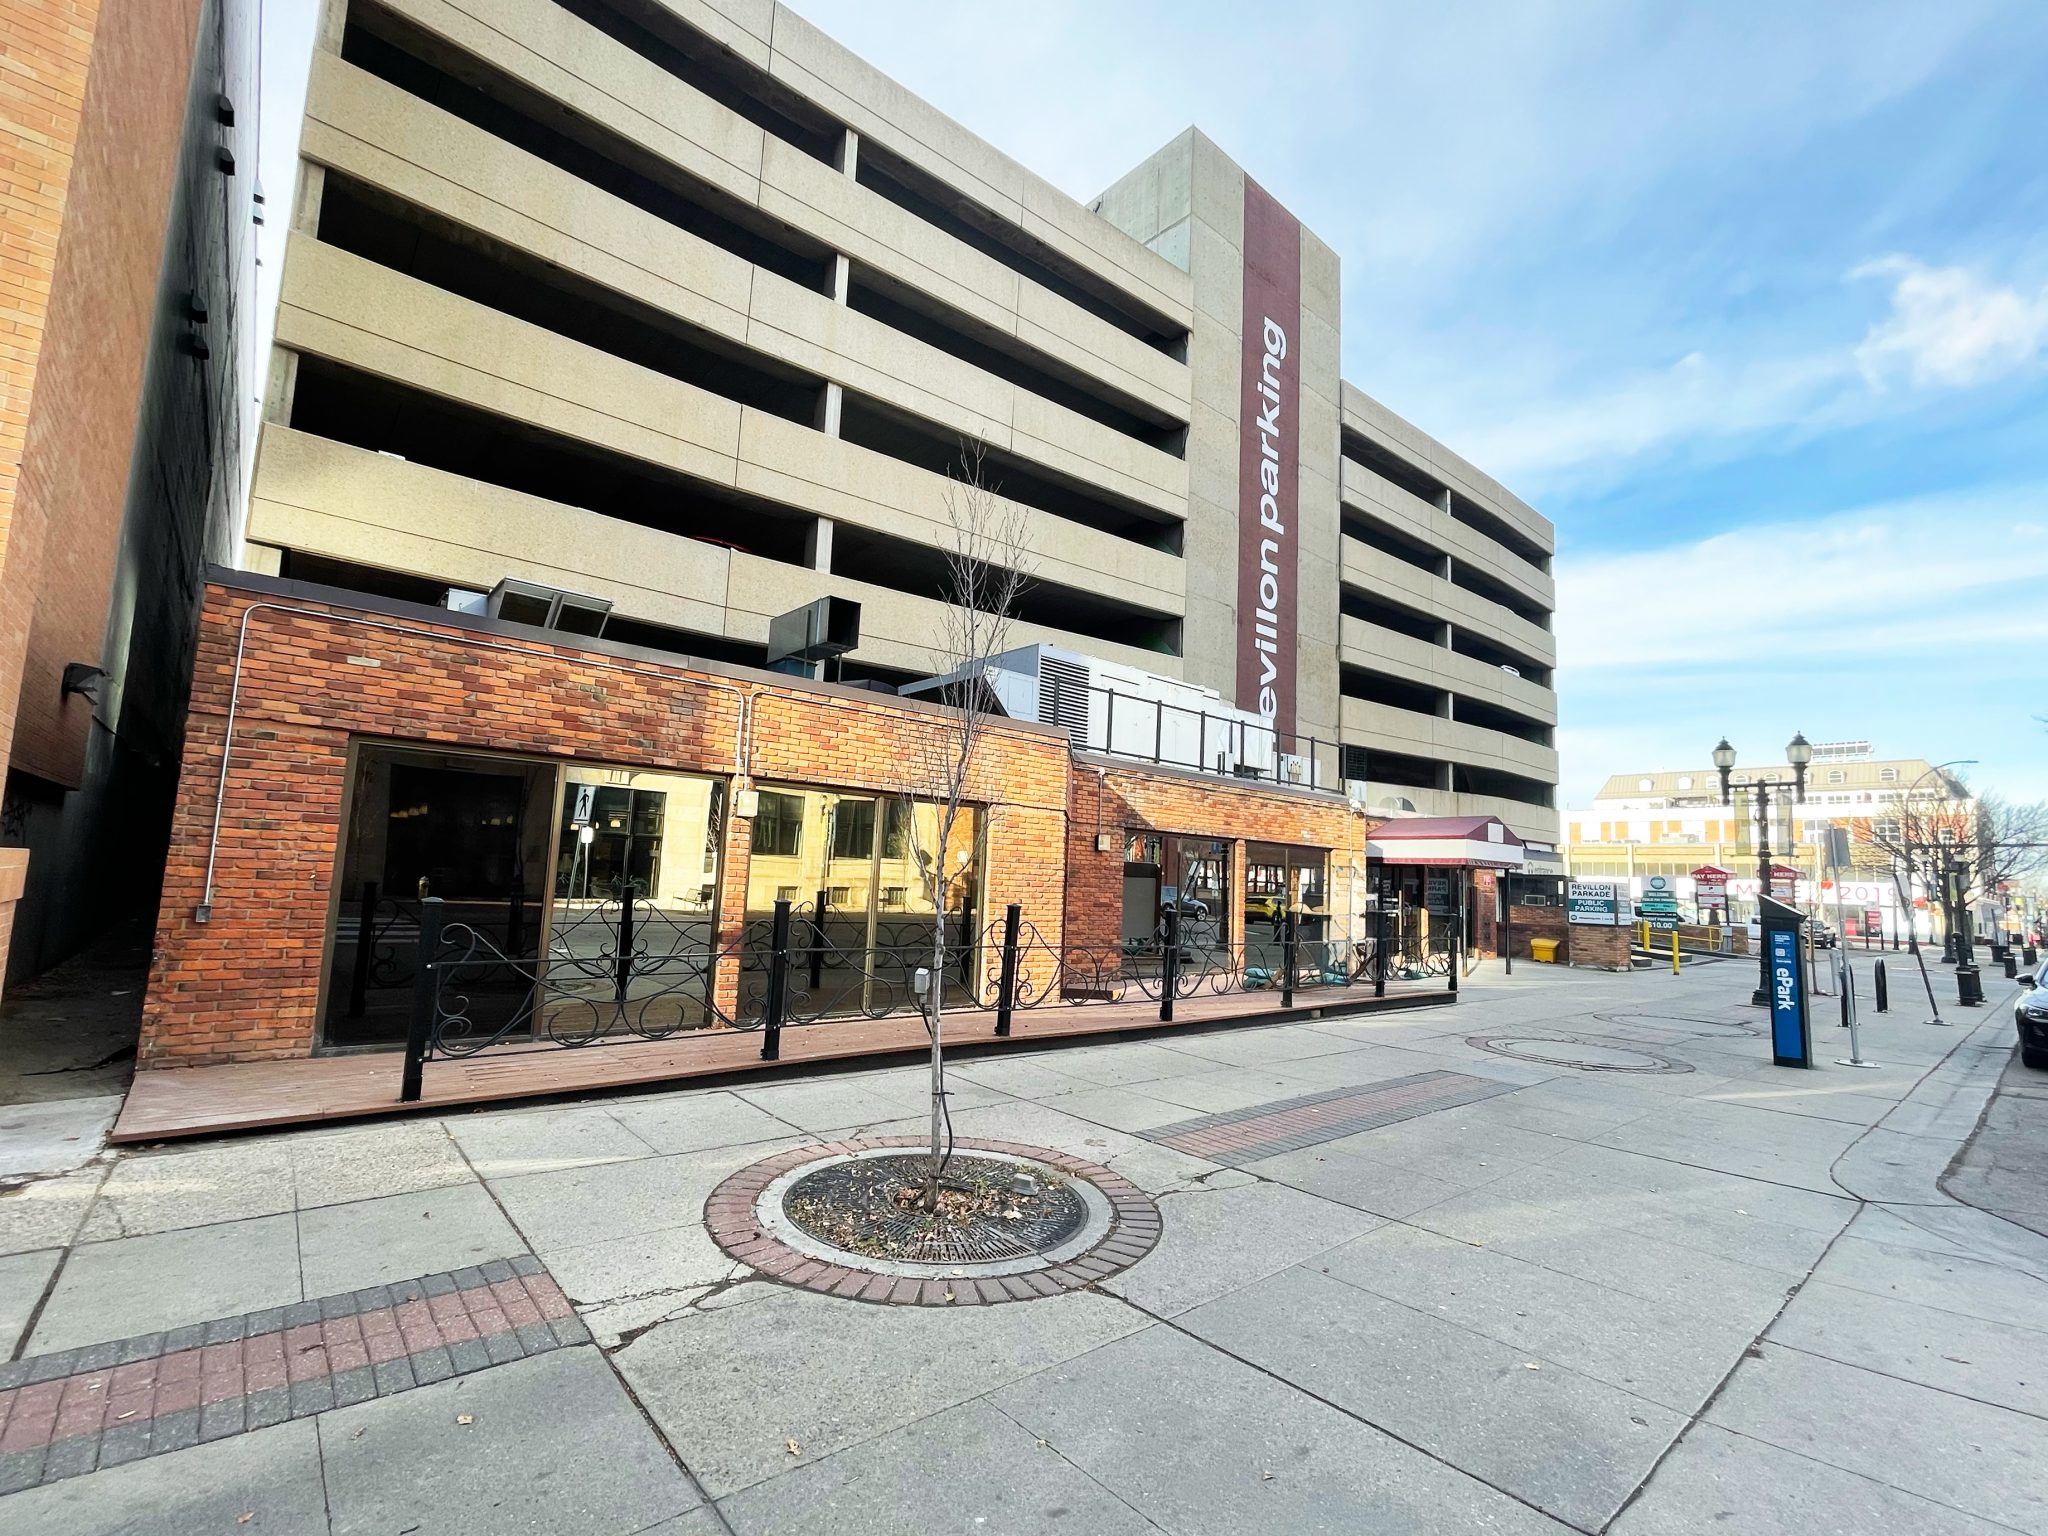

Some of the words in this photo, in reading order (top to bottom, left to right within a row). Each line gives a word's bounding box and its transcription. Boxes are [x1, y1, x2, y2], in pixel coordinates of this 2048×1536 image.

[1256, 316, 1287, 535] parking
[1254, 538, 1278, 720] evillon
[1571, 883, 1611, 891] REVILLON
[1572, 890, 1611, 898] PARKADE
[1776, 967, 1795, 1010] ePark
